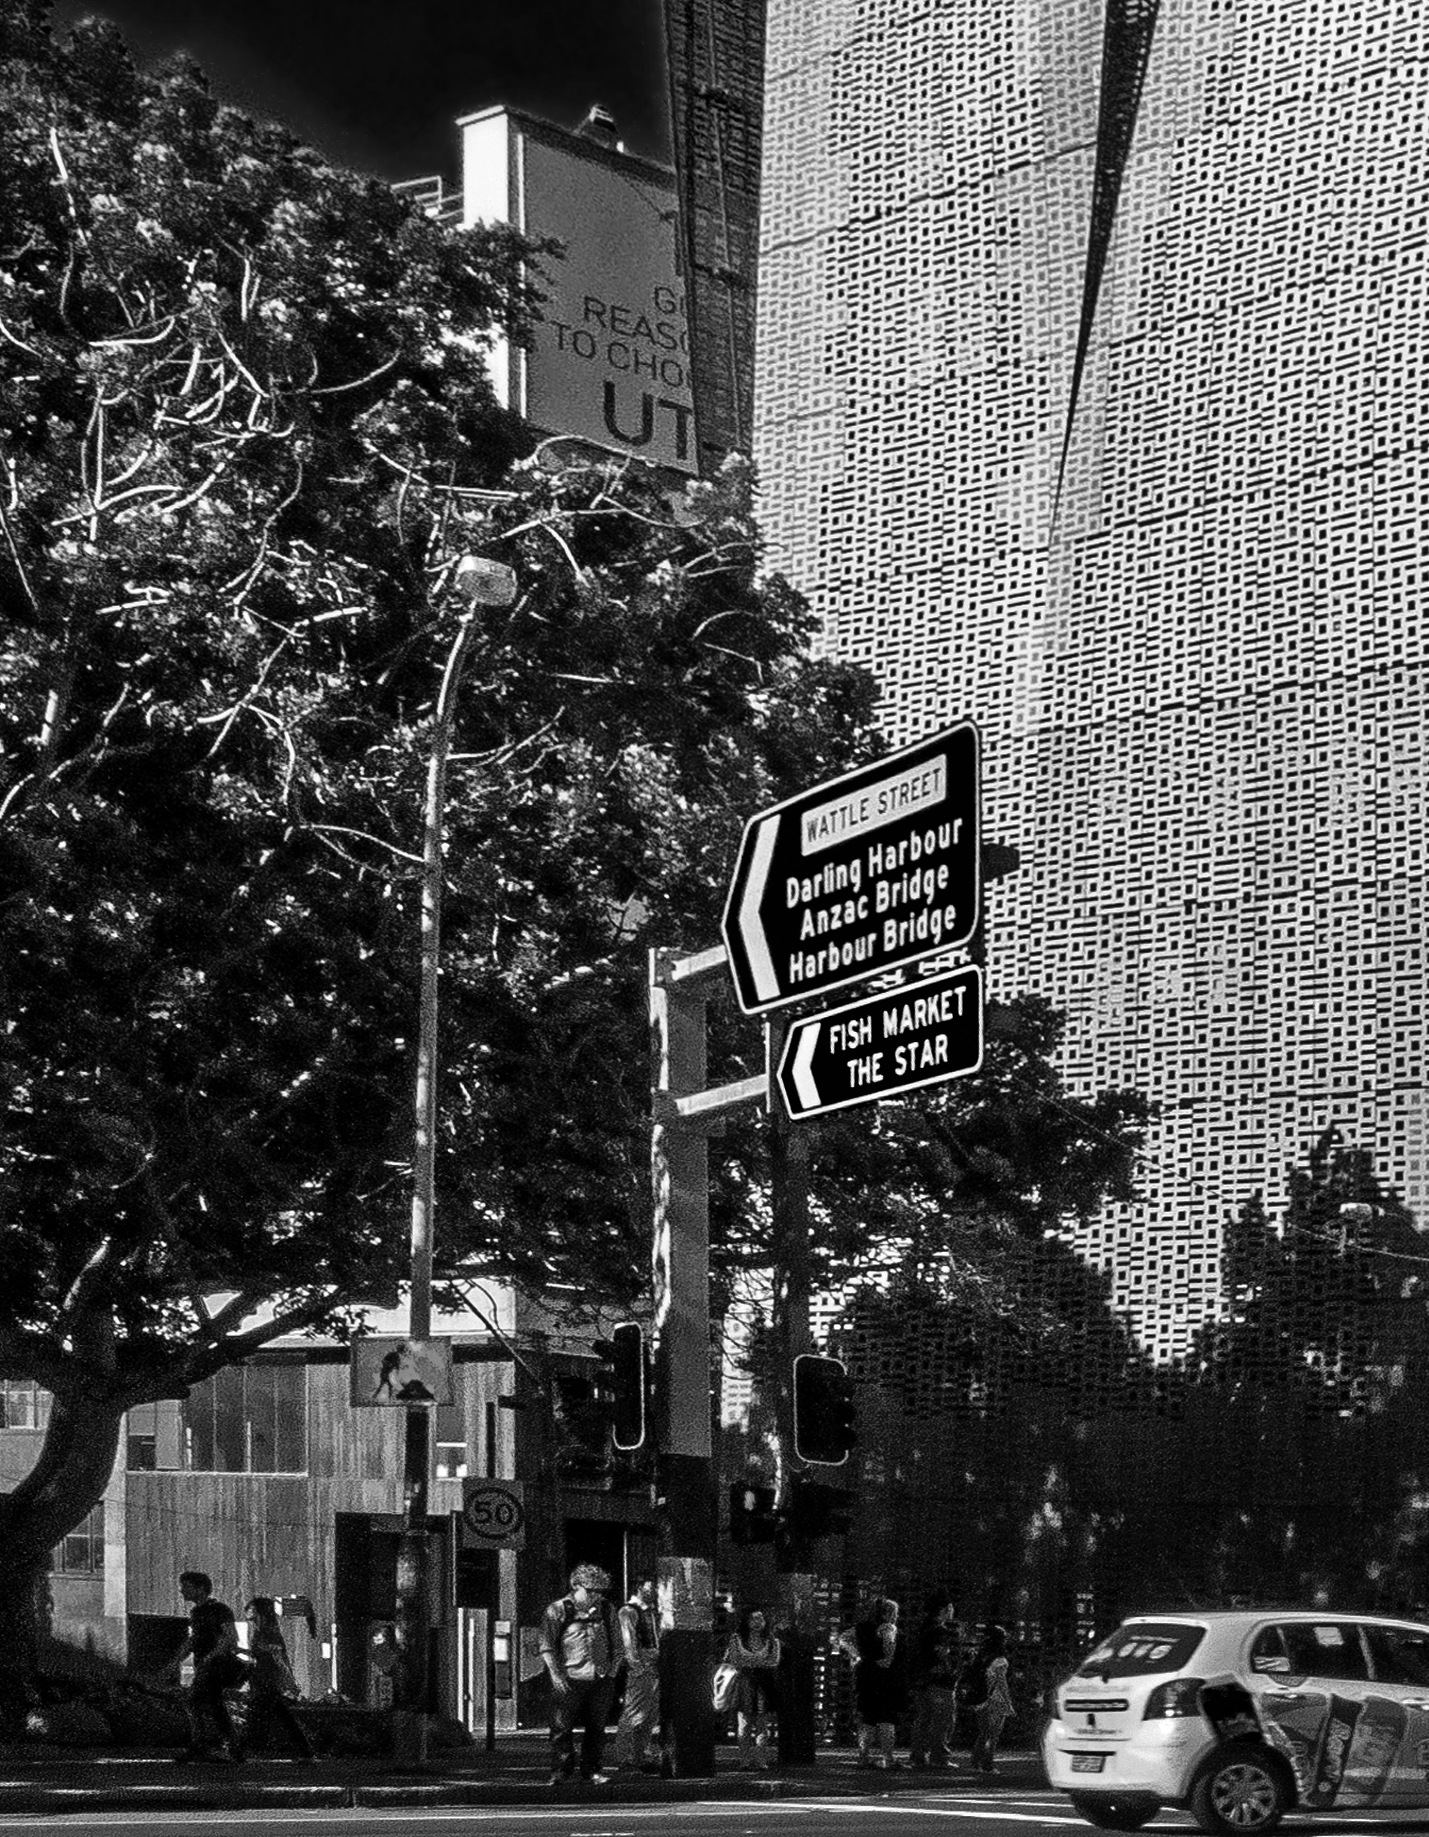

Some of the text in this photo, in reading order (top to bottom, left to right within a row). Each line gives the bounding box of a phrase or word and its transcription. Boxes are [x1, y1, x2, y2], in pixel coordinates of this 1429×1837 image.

[550, 320, 692, 389] TO CHO
[603, 378, 693, 461] UT
[806, 767, 942, 843] WATTLE STREET
[786, 817, 963, 909] Darling Harbour
[800, 864, 949, 941] Anzac Bridge
[789, 904, 957, 984] Harbour Bridge
[829, 985, 967, 1055] FISH MARKET
[846, 1033, 949, 1089] THE STAR
[475, 1501, 514, 1525] 50
